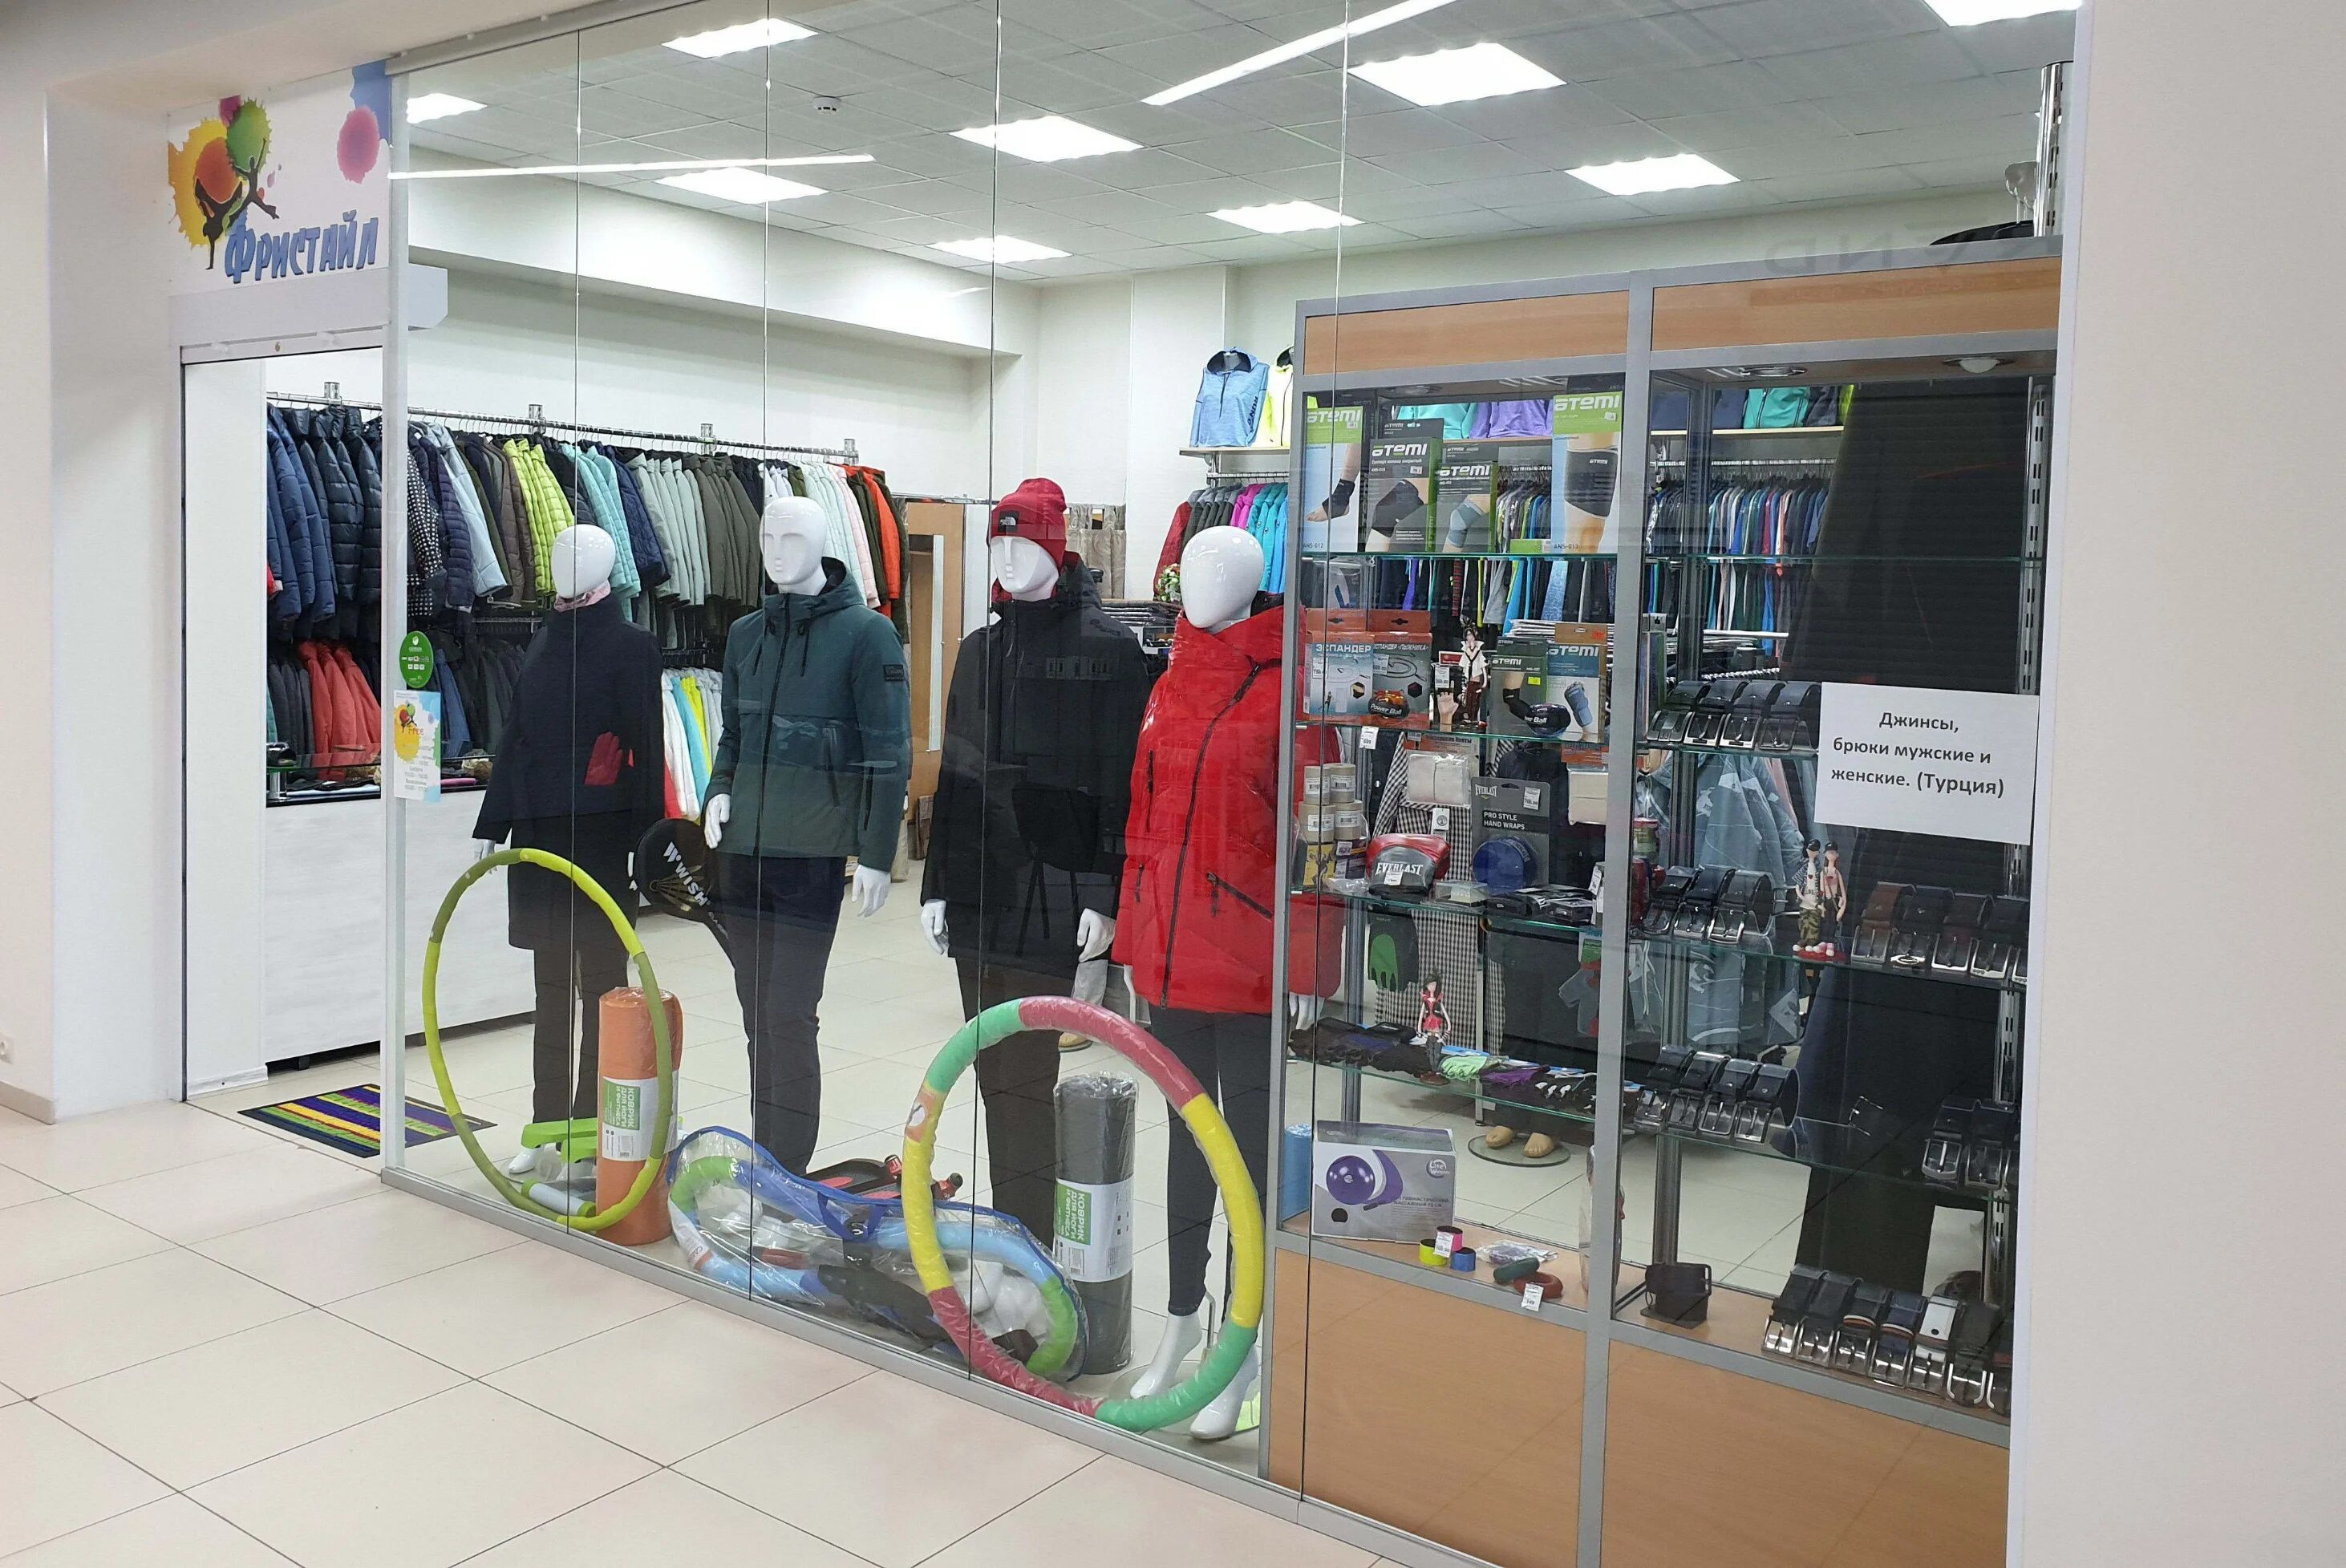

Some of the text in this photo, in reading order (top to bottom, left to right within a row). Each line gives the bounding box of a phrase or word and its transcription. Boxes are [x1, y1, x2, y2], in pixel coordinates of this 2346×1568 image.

[1879, 711, 1959, 733] Джинсы,
[1833, 737, 1991, 764] брюки мужские и
[1831, 768, 2004, 799] женские. (Турция)
[1503, 822, 1526, 830] WRAPS
[675, 861, 708, 906] WISH
[1375, 862, 1424, 876] EVERLAST
[627, 1088, 635, 1128] КОВРИК
[1077, 1193, 1085, 1241] КОВРИК
